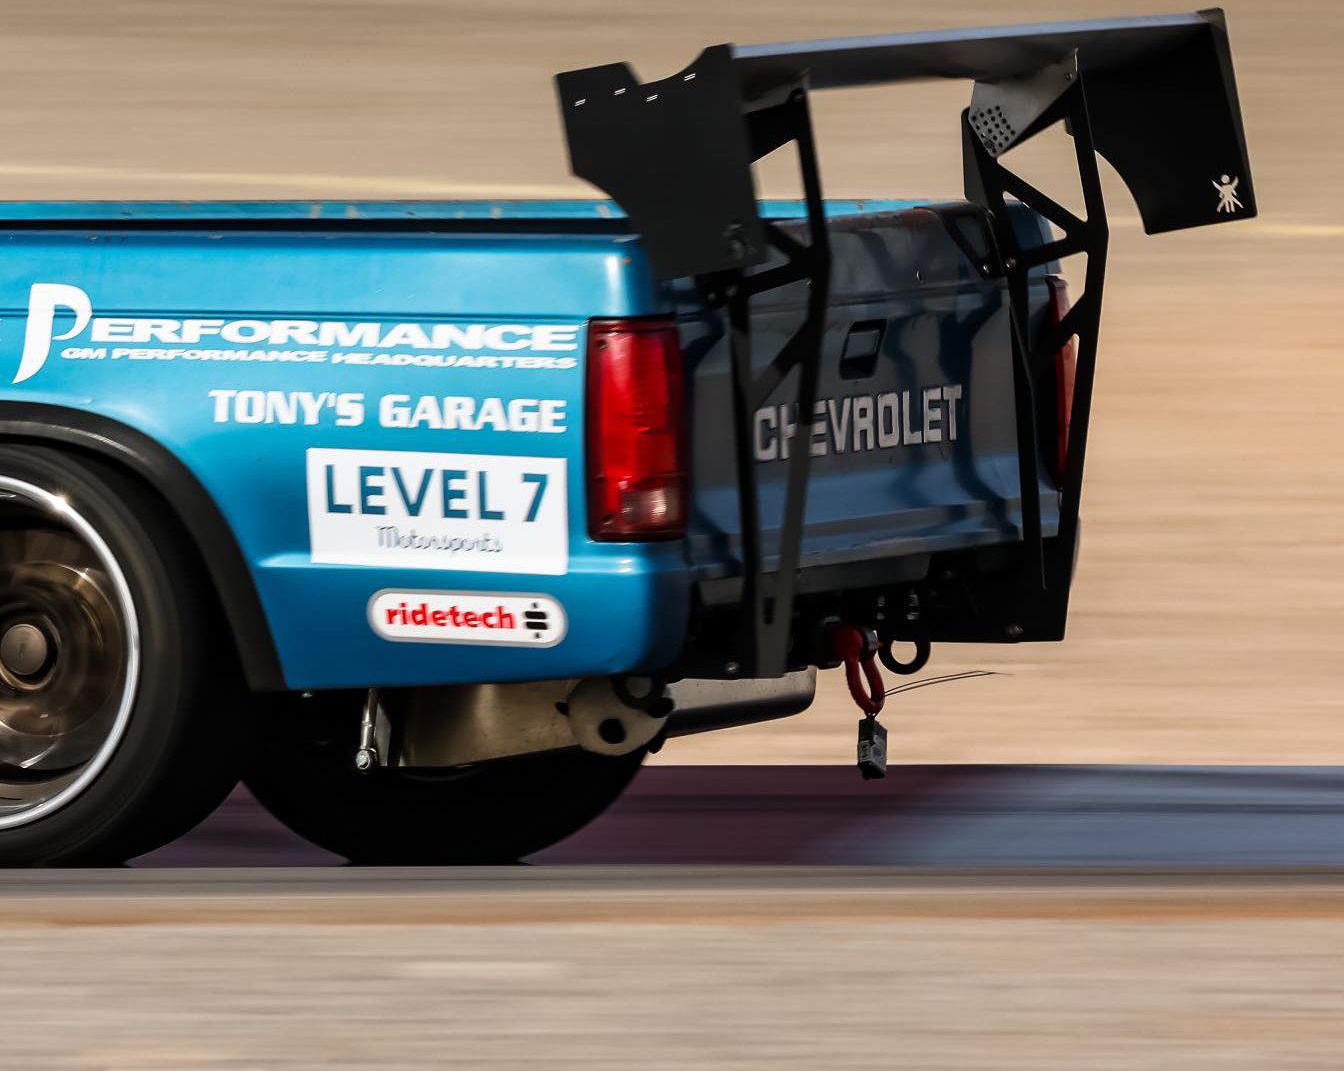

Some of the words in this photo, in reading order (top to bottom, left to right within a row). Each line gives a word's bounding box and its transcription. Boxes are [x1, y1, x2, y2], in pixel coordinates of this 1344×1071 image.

[12, 282, 579, 384] PERFORMANCE
[61, 346, 106, 360] GM
[111, 347, 330, 364] PERFORMANCE
[331, 351, 577, 369] HEADQUARTERS
[208, 389, 365, 426] TONY'S
[379, 393, 568, 434] GARAGE
[325, 464, 505, 521] LEVEL
[521, 472, 550, 523] 7
[376, 525, 505, 557] Motorsports
[384, 602, 517, 629] ridetech
